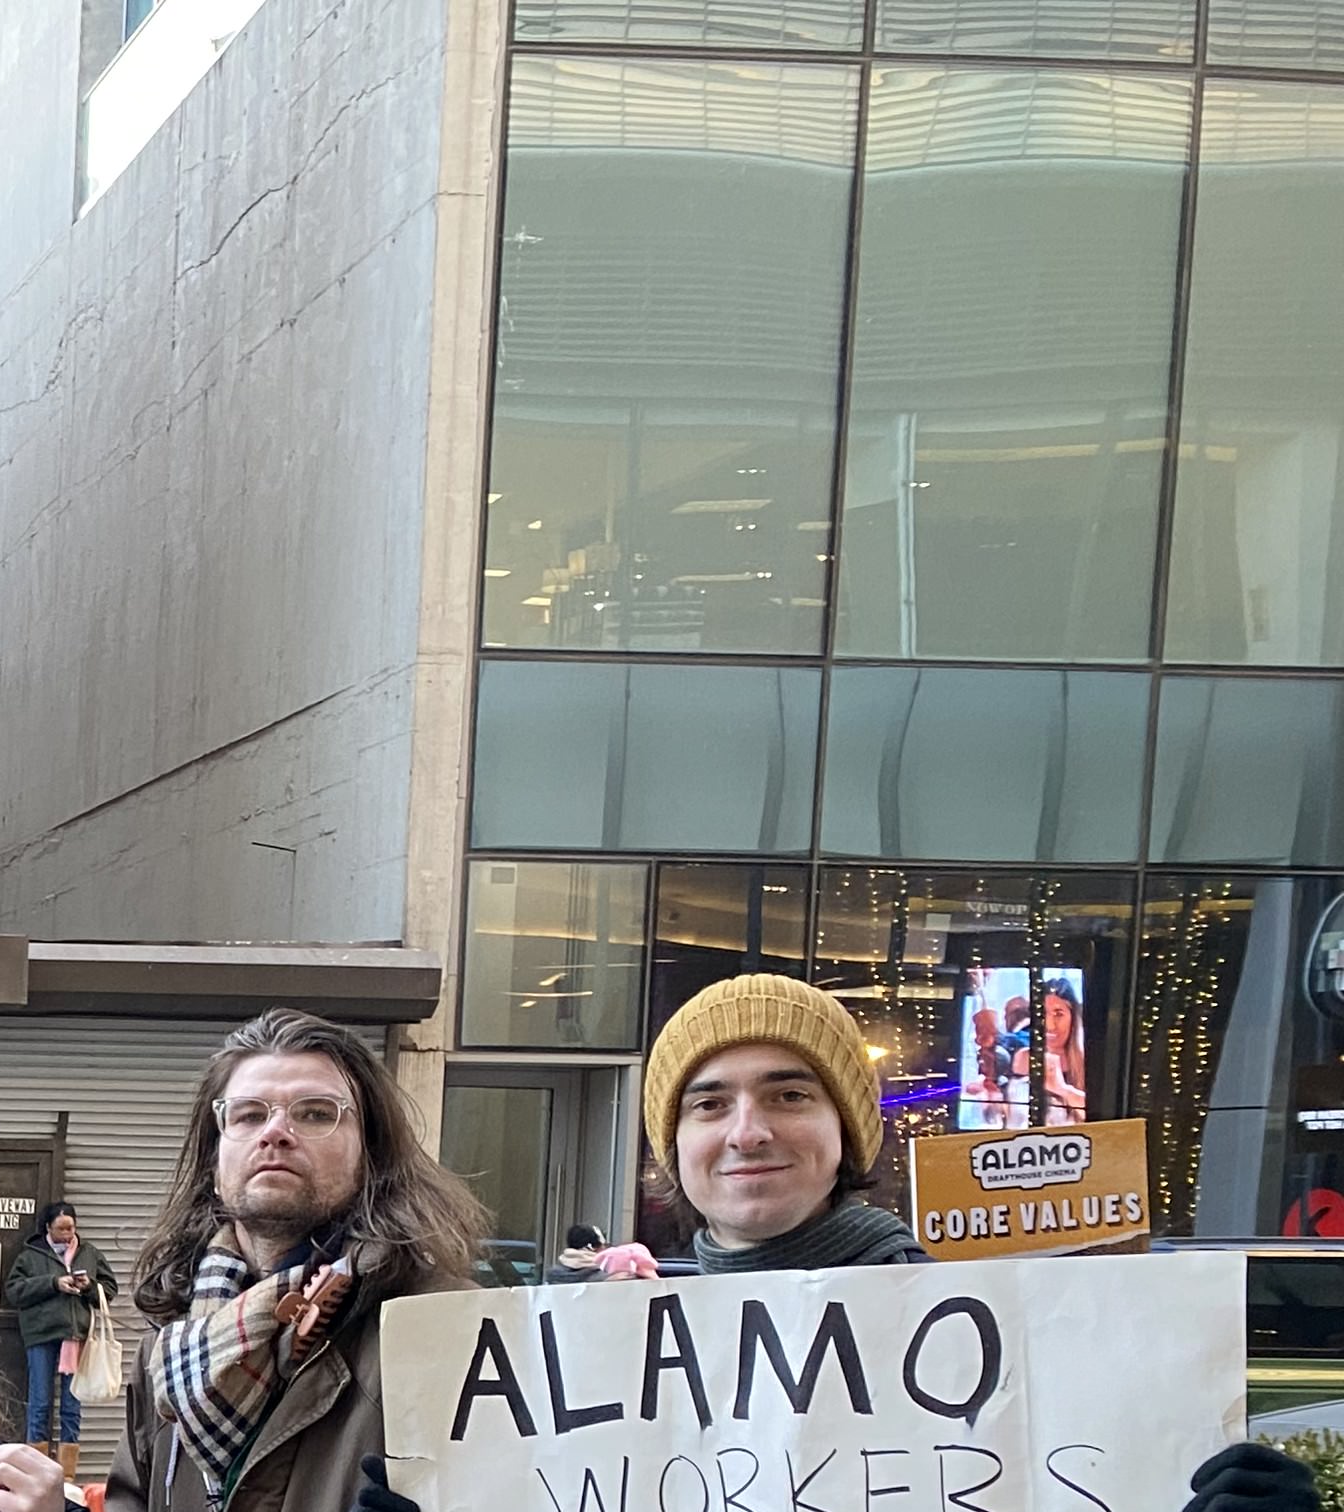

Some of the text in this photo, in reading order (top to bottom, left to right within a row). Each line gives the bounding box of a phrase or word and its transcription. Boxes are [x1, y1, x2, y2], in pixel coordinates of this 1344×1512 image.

[1005, 904, 1028, 915] OP
[982, 1142, 1082, 1171] ALAMO
[987, 1168, 1077, 1183] DRAFTHOUSE CINEMA
[924, 1191, 1142, 1243] CORE VALUES
[451, 1294, 1003, 1441] ALAMO
